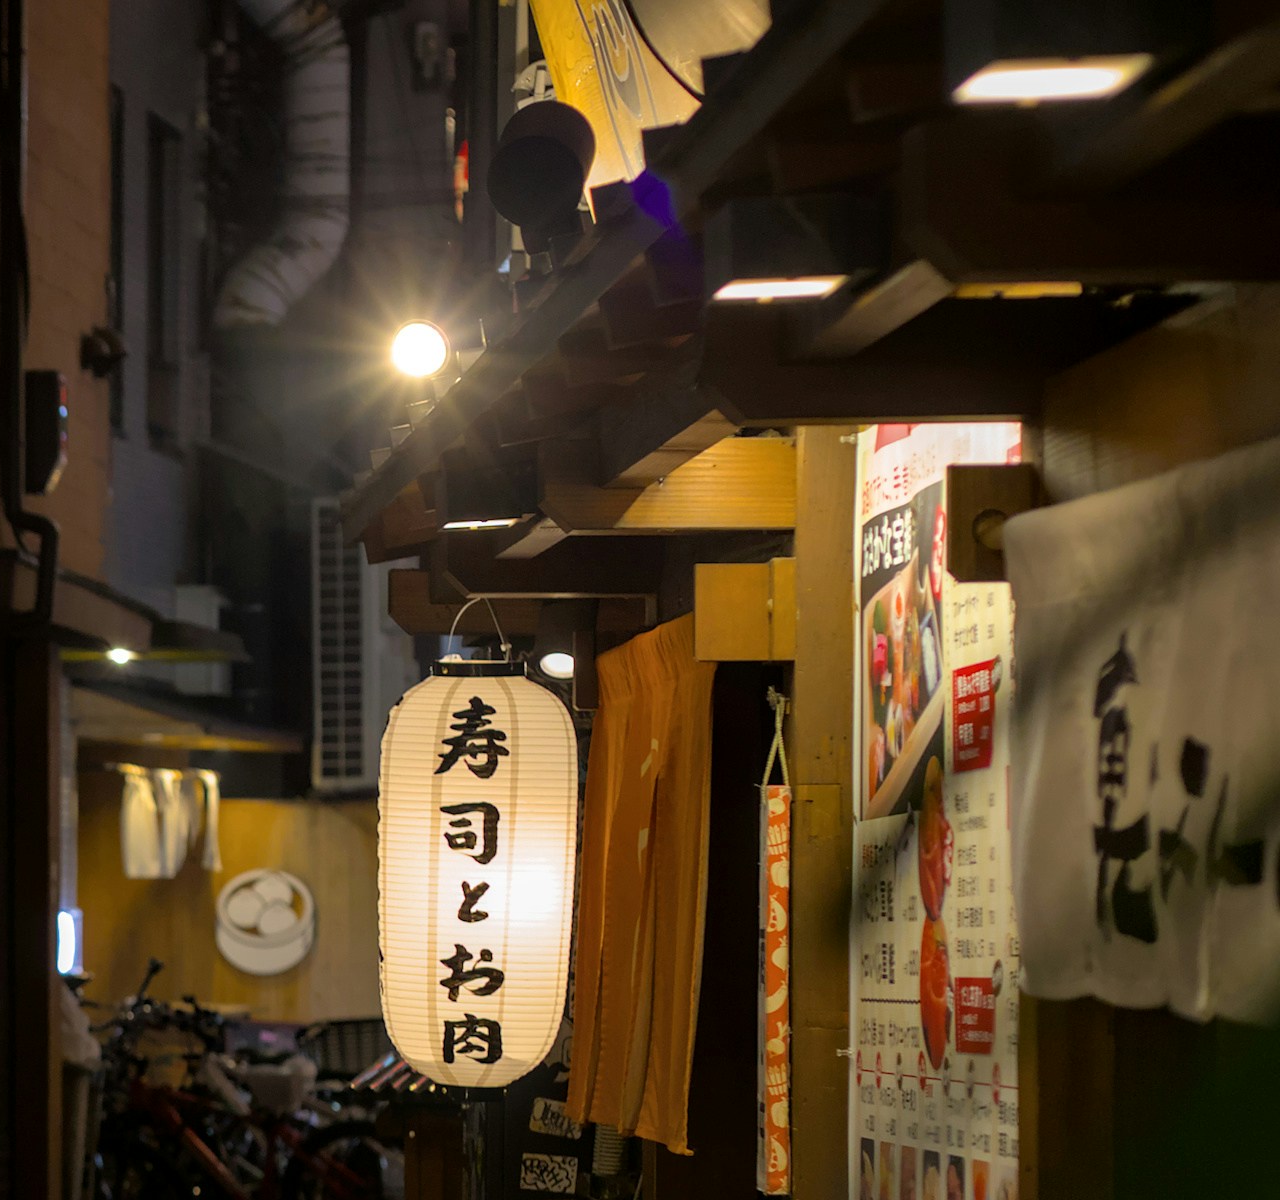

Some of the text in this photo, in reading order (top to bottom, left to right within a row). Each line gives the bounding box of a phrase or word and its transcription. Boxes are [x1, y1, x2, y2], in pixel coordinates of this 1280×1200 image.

[433, 696, 510, 1065] 寿司とお肉
